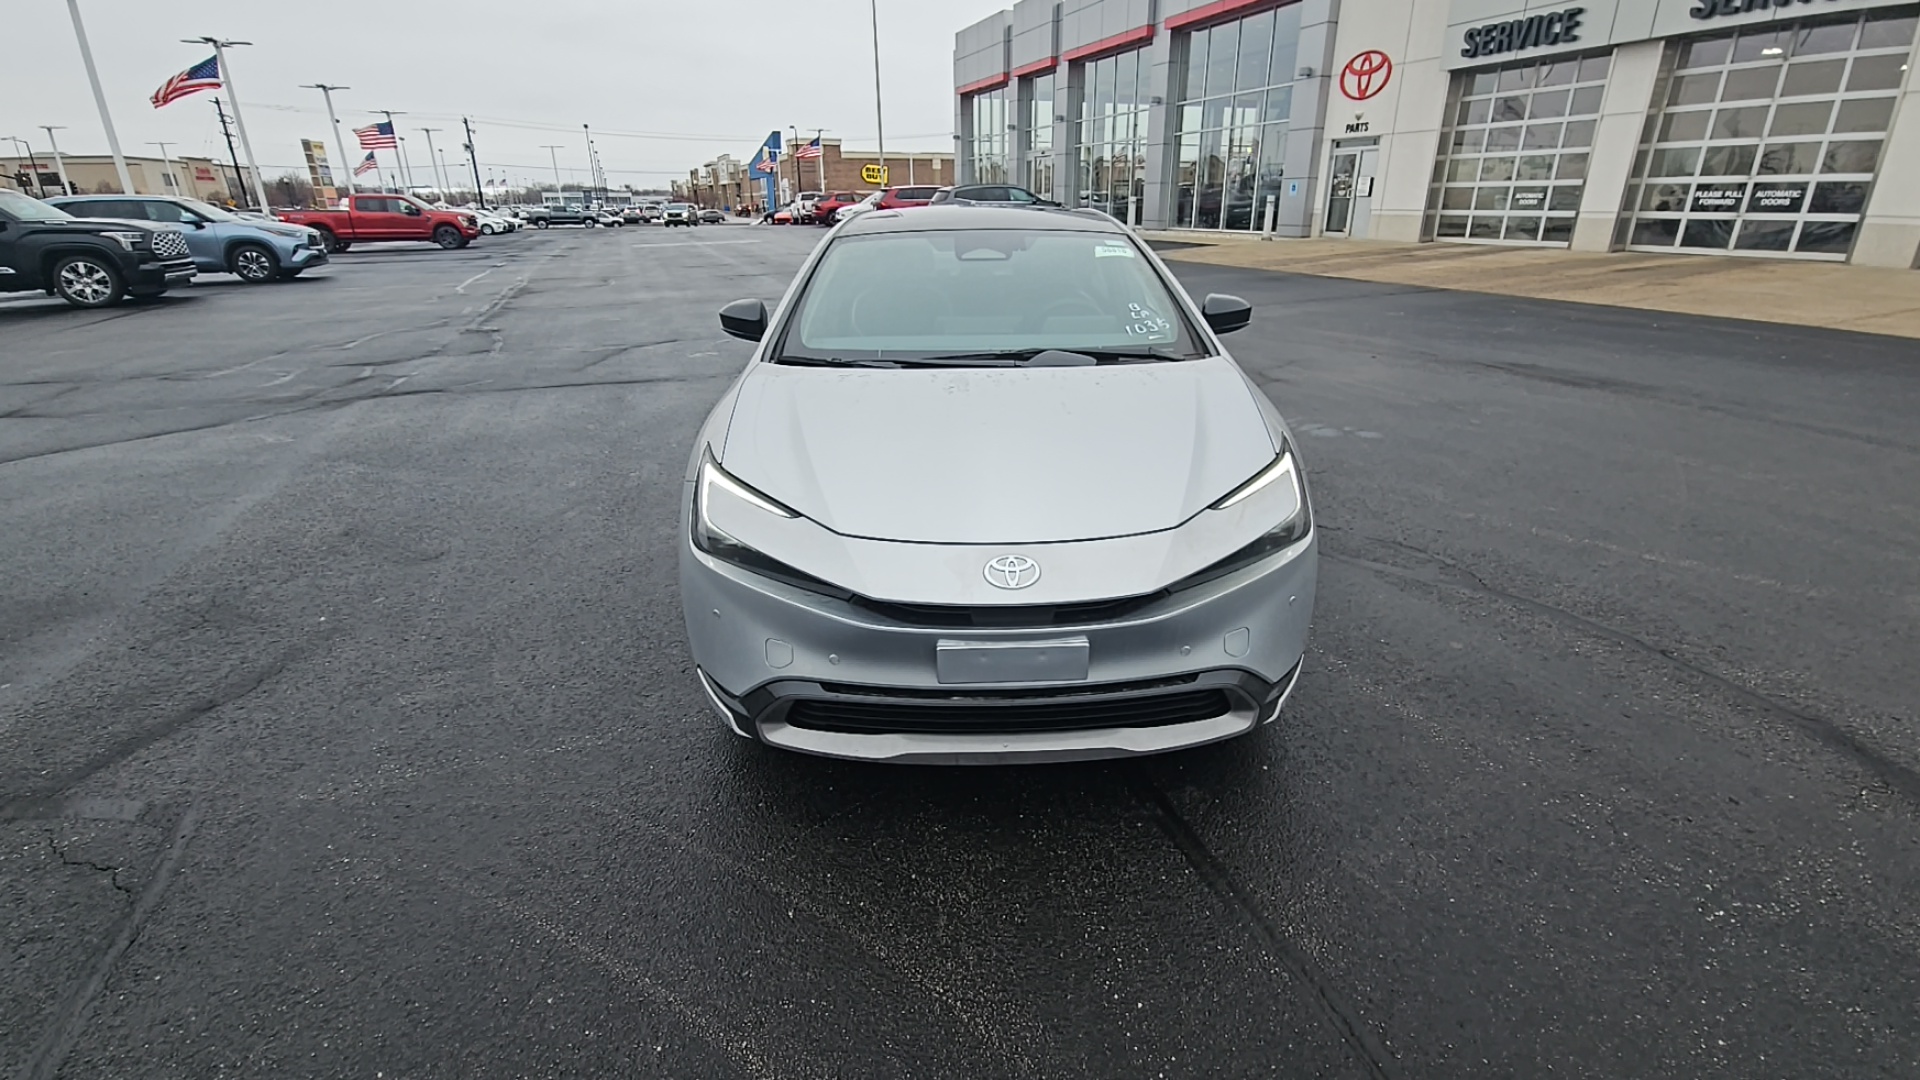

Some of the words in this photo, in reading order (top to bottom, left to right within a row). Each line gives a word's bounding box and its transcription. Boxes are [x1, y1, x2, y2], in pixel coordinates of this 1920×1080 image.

[1461, 7, 1586, 58] SERVICE
[1345, 122, 1370, 134] PARTS
[1695, 190, 1723, 198] PLEASE
[1724, 190, 1744, 198] PULL
[1754, 190, 1802, 198] AUTOMATIC
[1699, 198, 1736, 206] FORWARD
[1760, 198, 1791, 206] DOORS
[1125, 317, 1170, 337] 1035
